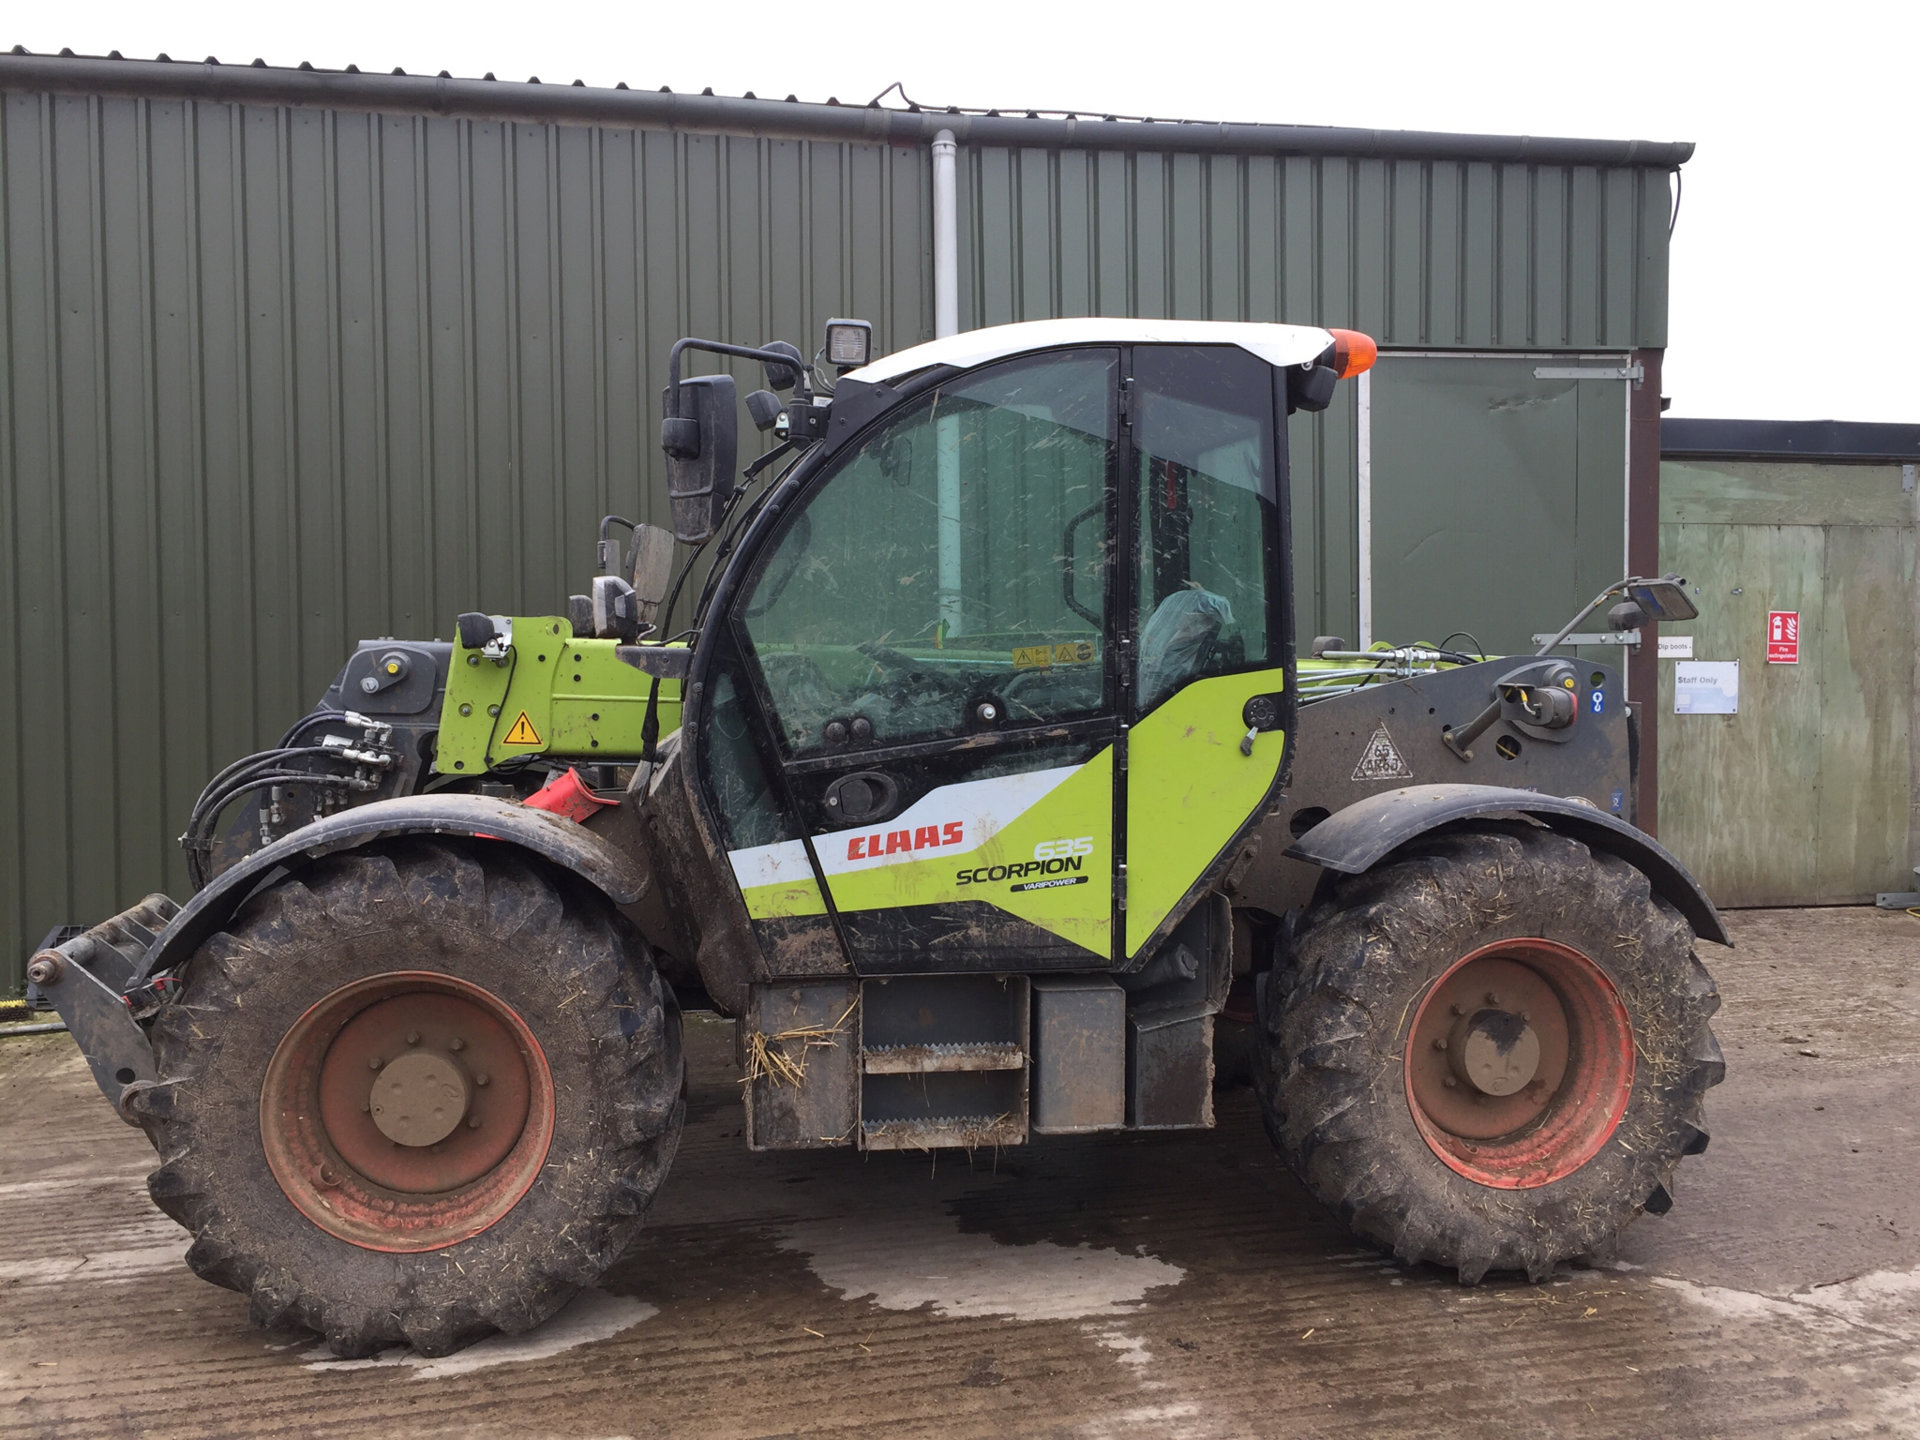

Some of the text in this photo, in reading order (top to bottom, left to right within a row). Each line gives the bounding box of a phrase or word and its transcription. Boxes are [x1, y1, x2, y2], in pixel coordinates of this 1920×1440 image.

[1699, 677, 1718, 685] Only
[1374, 744, 1390, 758] 65
[847, 821, 963, 861] CLAAS
[1033, 836, 1094, 862] 635
[956, 855, 1083, 886] SCORPION
[1023, 877, 1078, 891] VARIPOWER
